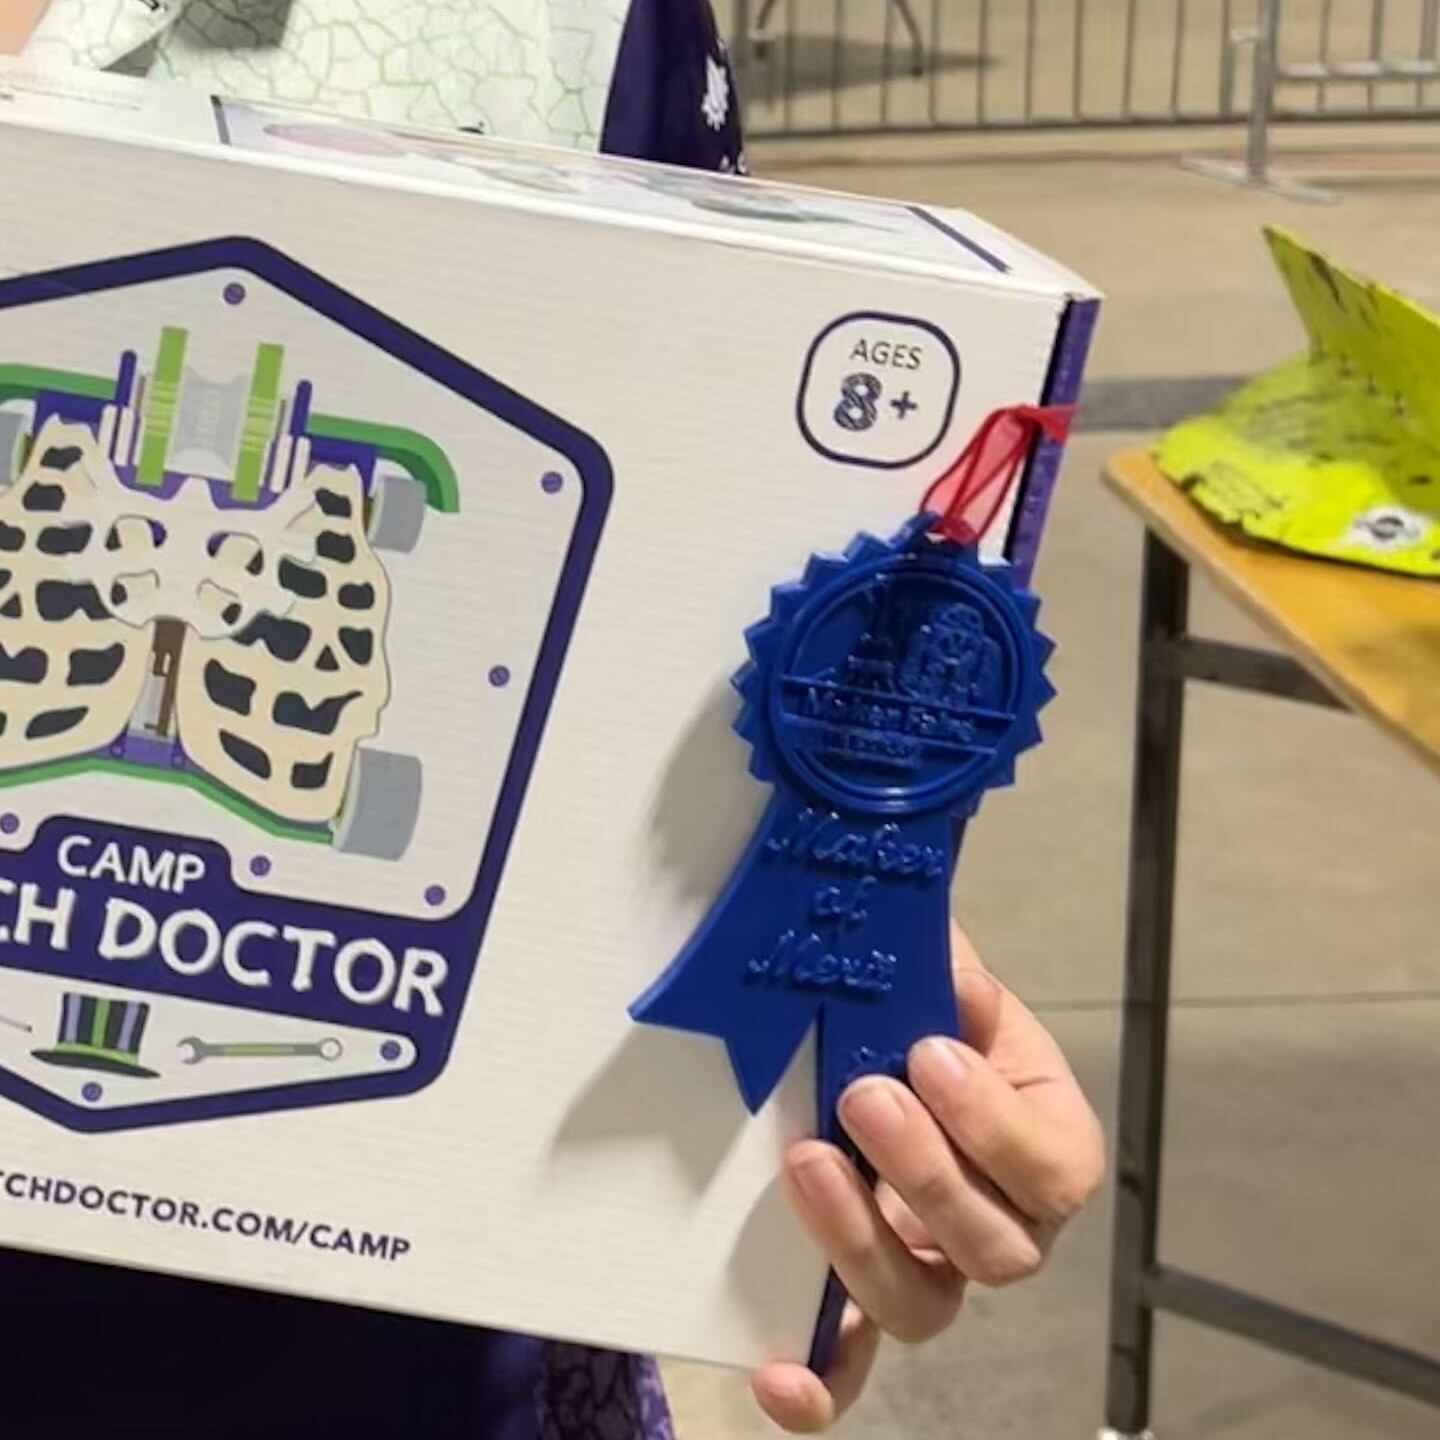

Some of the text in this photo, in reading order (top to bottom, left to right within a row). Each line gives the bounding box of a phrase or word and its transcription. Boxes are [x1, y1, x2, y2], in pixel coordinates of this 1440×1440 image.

[849, 338, 923, 371] AGES
[833, 372, 918, 431] 8+
[57, 834, 206, 894] CAMP
[98, 895, 449, 1017] DOCTOR
